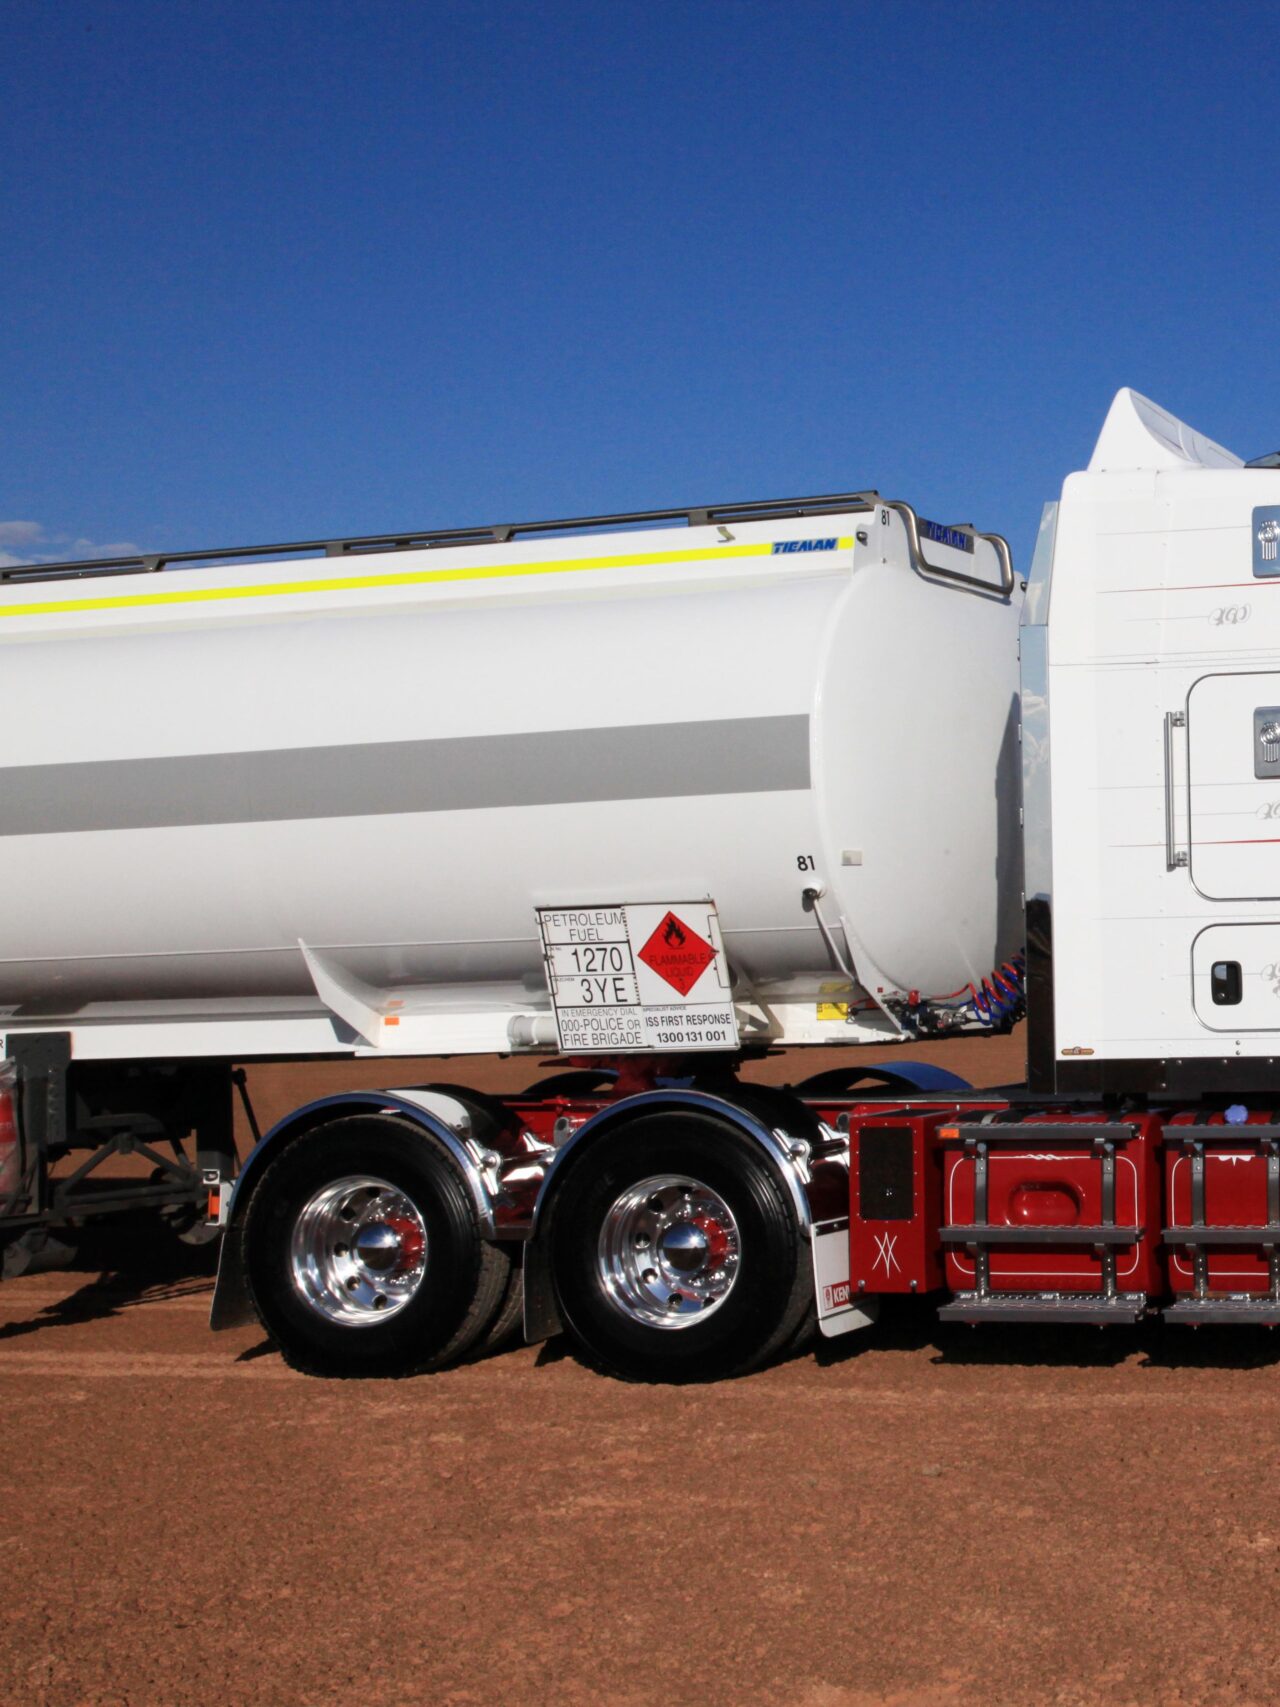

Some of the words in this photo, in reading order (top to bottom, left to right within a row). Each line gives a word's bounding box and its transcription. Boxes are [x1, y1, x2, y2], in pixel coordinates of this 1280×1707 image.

[881, 509, 890, 526] 81
[773, 538, 838, 553] TIEMAN
[797, 855, 815, 871] 81
[543, 912, 622, 926] PETROLEUM
[569, 928, 604, 941] FUEL
[571, 947, 623, 972] 1270
[581, 977, 628, 1003] 3YE
[561, 1009, 569, 1017] IN
[571, 1008, 618, 1017] EMERGENCY
[620, 1007, 638, 1016] DIAL
[561, 1017, 624, 1031] 000-POLICE
[627, 1019, 641, 1030] OR
[645, 1016, 659, 1027] ISS
[661, 1015, 683, 1026] FIRST
[686, 1013, 731, 1025] RESPONSE
[563, 1033, 589, 1046] FIRE
[592, 1031, 643, 1045] BRIGADE
[657, 1032, 684, 1043] 1300
[685, 1031, 703, 1042] 131
[706, 1030, 726, 1041] 001
